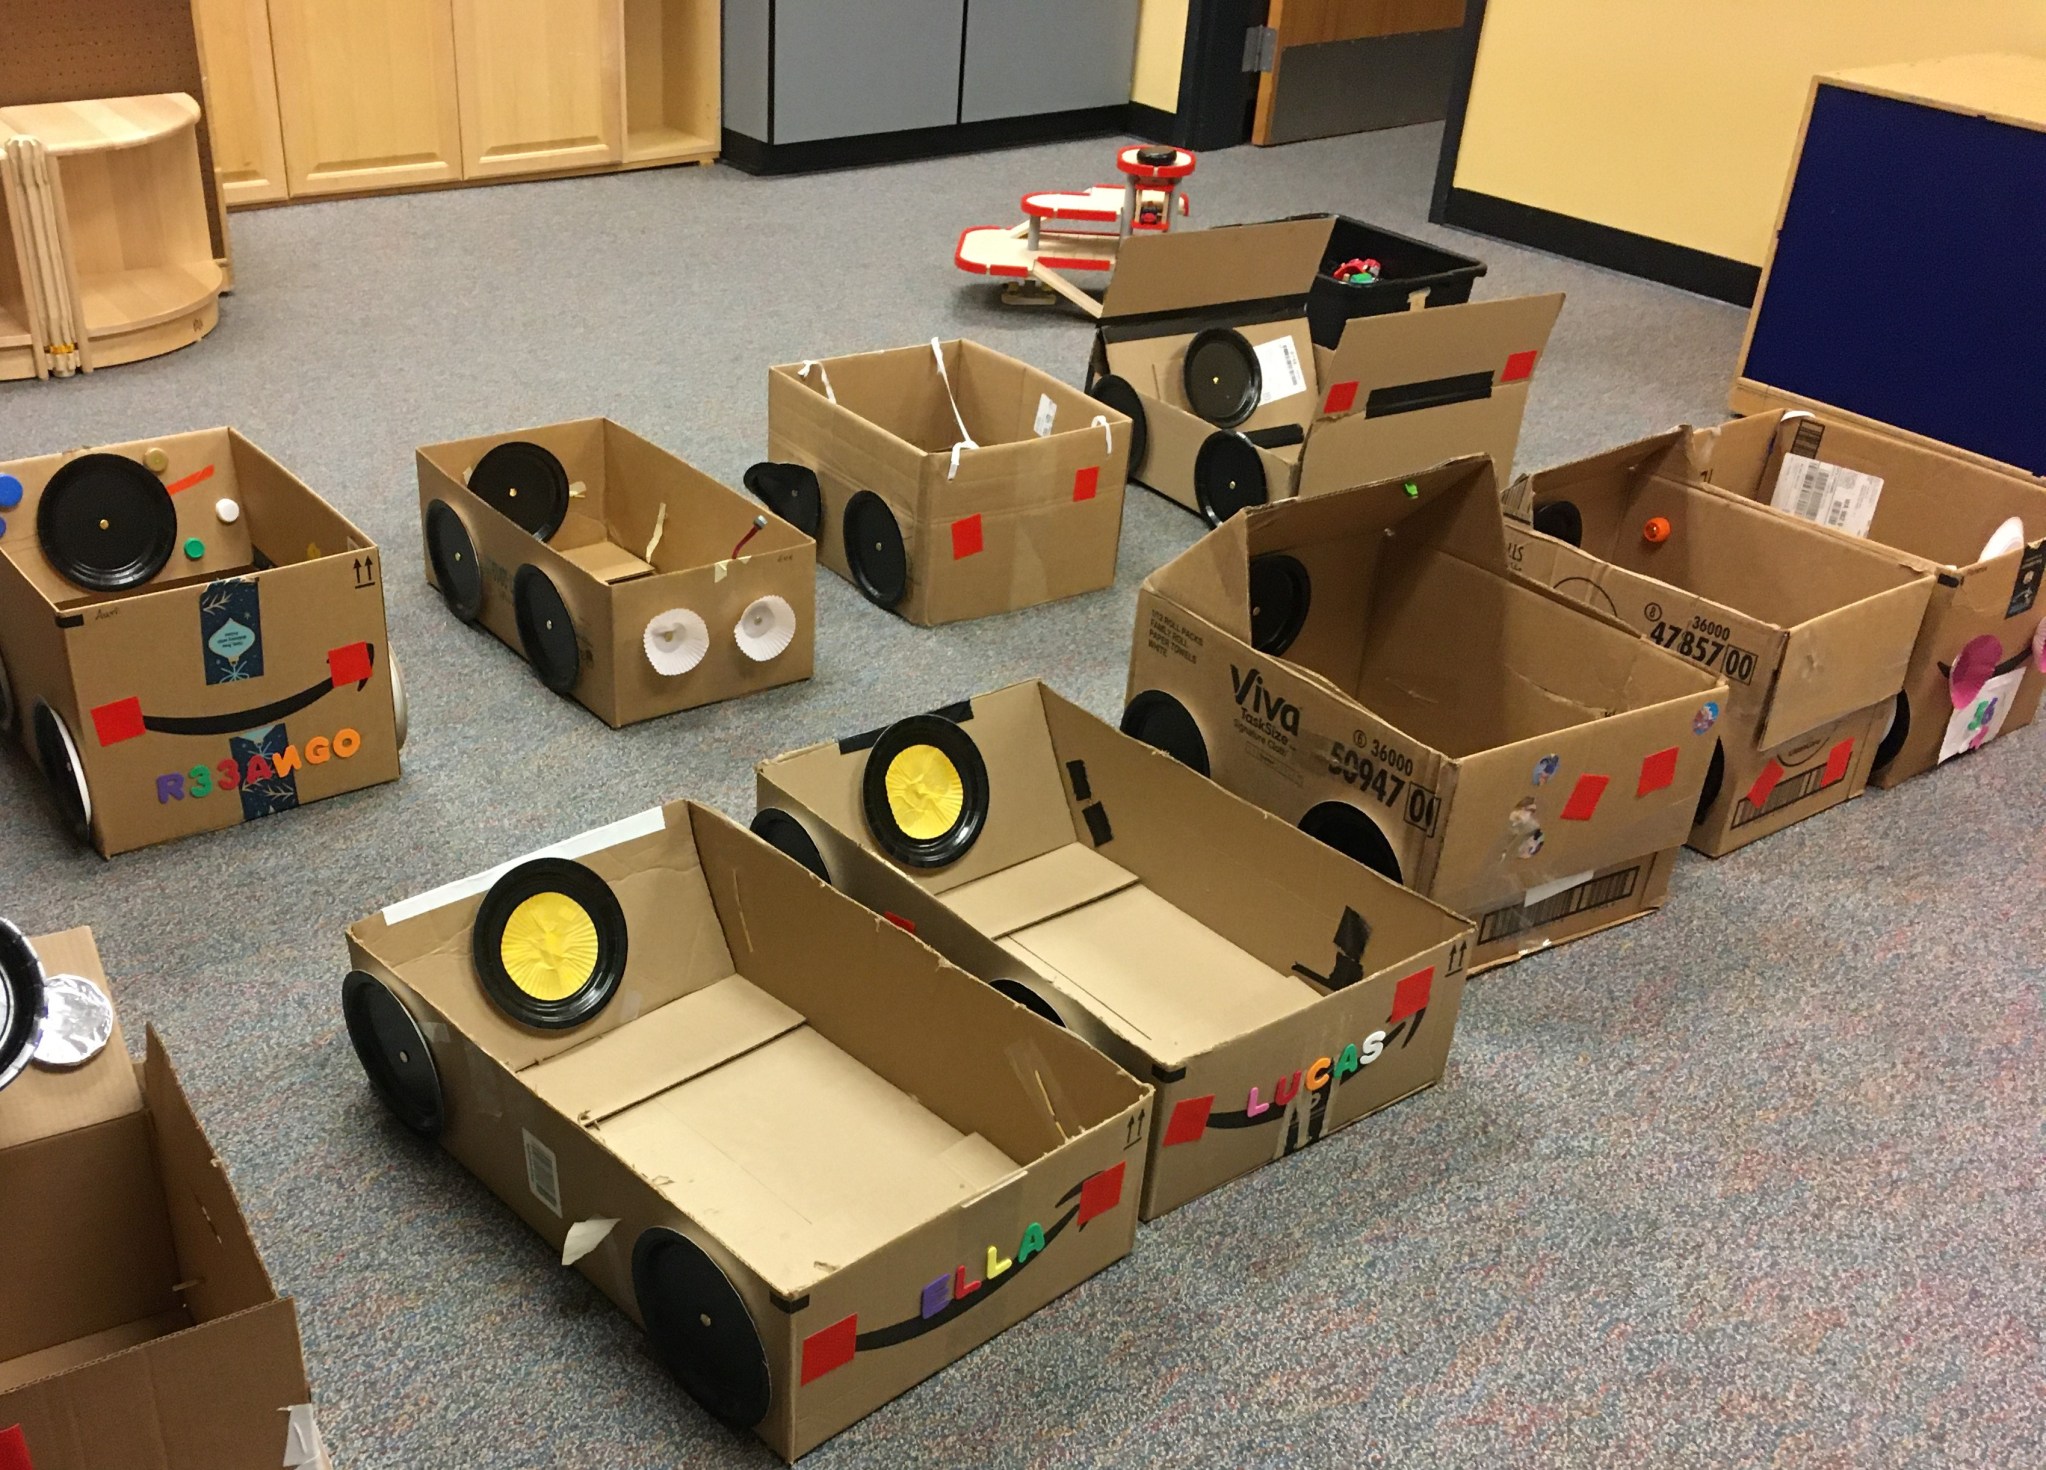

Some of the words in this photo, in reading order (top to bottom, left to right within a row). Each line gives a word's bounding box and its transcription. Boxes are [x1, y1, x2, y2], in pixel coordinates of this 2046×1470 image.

[1148, 638, 1168, 658] WHITE
[1149, 628, 1170, 648] PAPER
[1650, 621, 1726, 667] 47857
[1692, 615, 1731, 641] 36000
[1229, 663, 1300, 737] Viva
[1241, 706, 1289, 746] TaskSize
[1327, 740, 1406, 809] 50947
[1370, 738, 1414, 777] 36000
[1246, 1029, 1387, 1118] LUCAS
[920, 1221, 1046, 1320] ELLA
